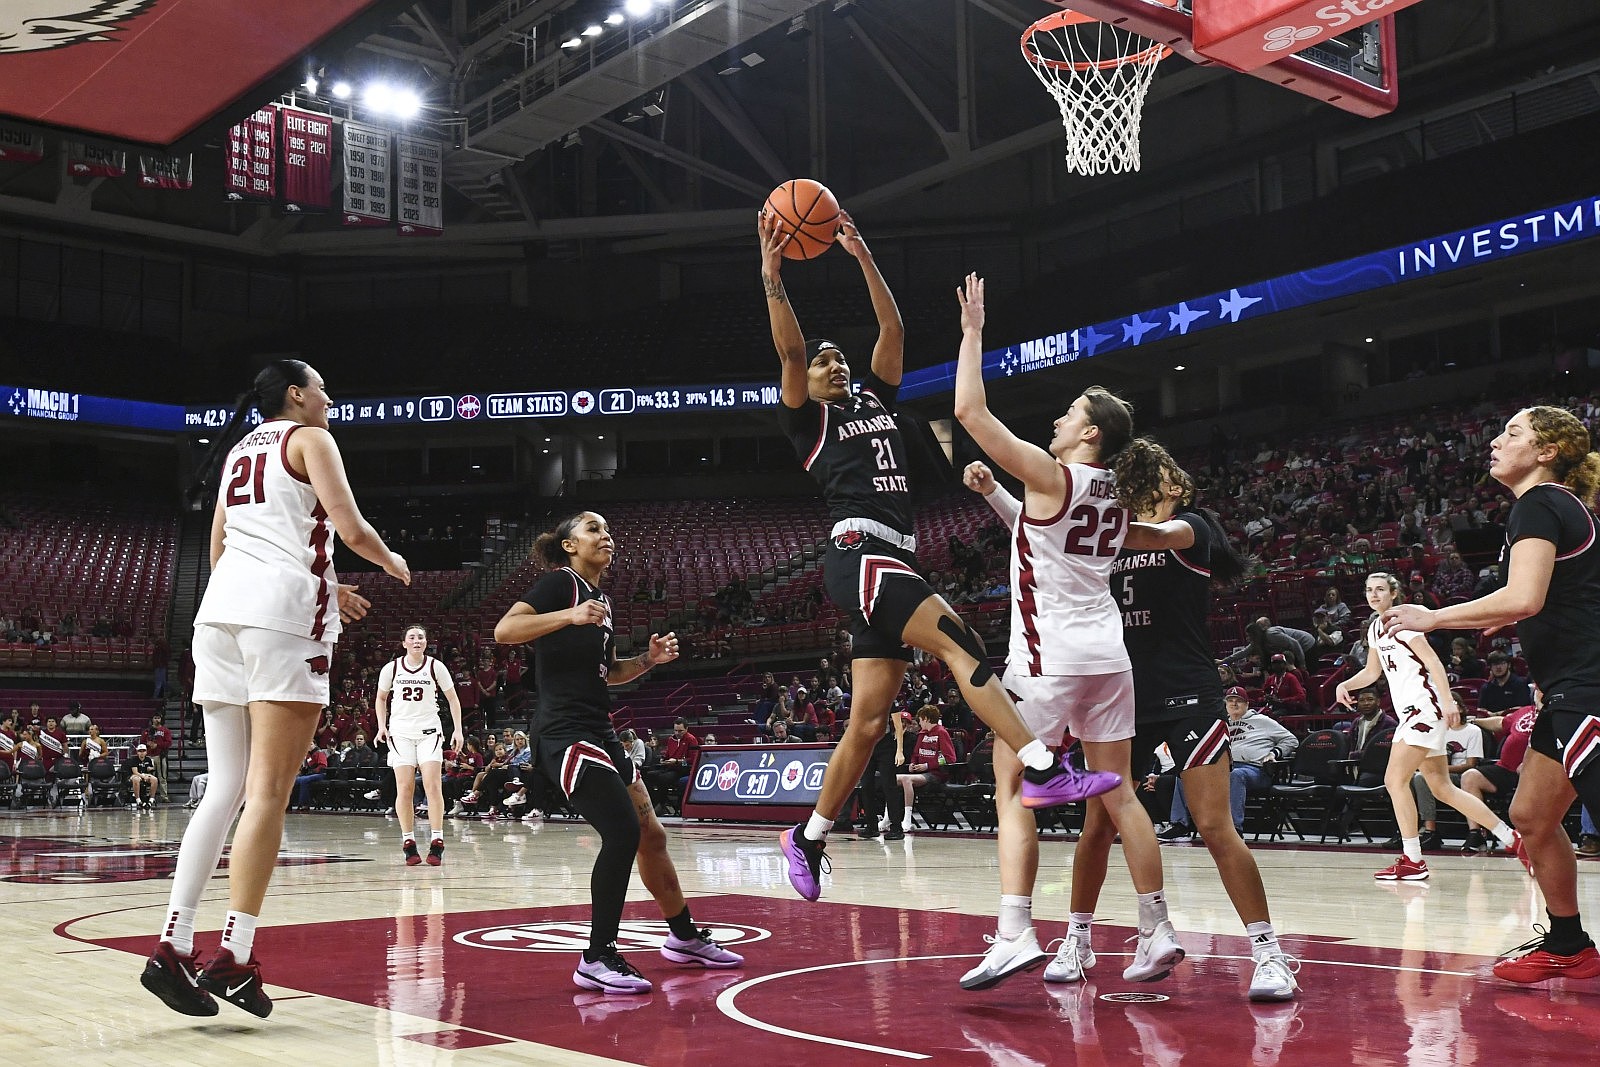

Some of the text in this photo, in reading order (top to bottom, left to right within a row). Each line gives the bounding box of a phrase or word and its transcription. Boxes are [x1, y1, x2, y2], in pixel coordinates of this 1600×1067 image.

[287, 115, 328, 136] ELITE EIGHT
[289, 137, 326, 154] 1995 2021
[348, 132, 365, 143] SWEET
[289, 153, 305, 166] 2022
[1020, 329, 1079, 364] MACH 1
[1021, 352, 1079, 373] FINANCIAL GROUP
[27, 388, 79, 413] MACH 1
[491, 395, 563, 415] TEAM STATS
[610, 393, 625, 411] 21
[637, 394, 654, 407] FG%
[654, 391, 680, 409] 33.3
[685, 392, 707, 405] 3PT%
[709, 388, 735, 407] 14.3
[742, 390, 759, 403] FT%
[28, 408, 78, 421] FINANCIAL GROUP
[186, 413, 202, 425] FG%
[203, 409, 227, 426] 42.9
[340, 404, 354, 421] 13
[360, 406, 372, 418] AST
[376, 403, 385, 419] 4
[393, 405, 402, 416] TO
[406, 401, 415, 419] 9
[429, 400, 444, 417] 19
[871, 437, 897, 470] 21
[227, 452, 267, 507] 21
[873, 475, 908, 492] STATE
[1064, 504, 1124, 557] 22
[1110, 552, 1166, 574] RKANSAS
[1122, 575, 1134, 606] 5
[402, 686, 424, 701] 23
[759, 753, 768, 768] 2
[700, 769, 824, 794] 19 9:11 21
